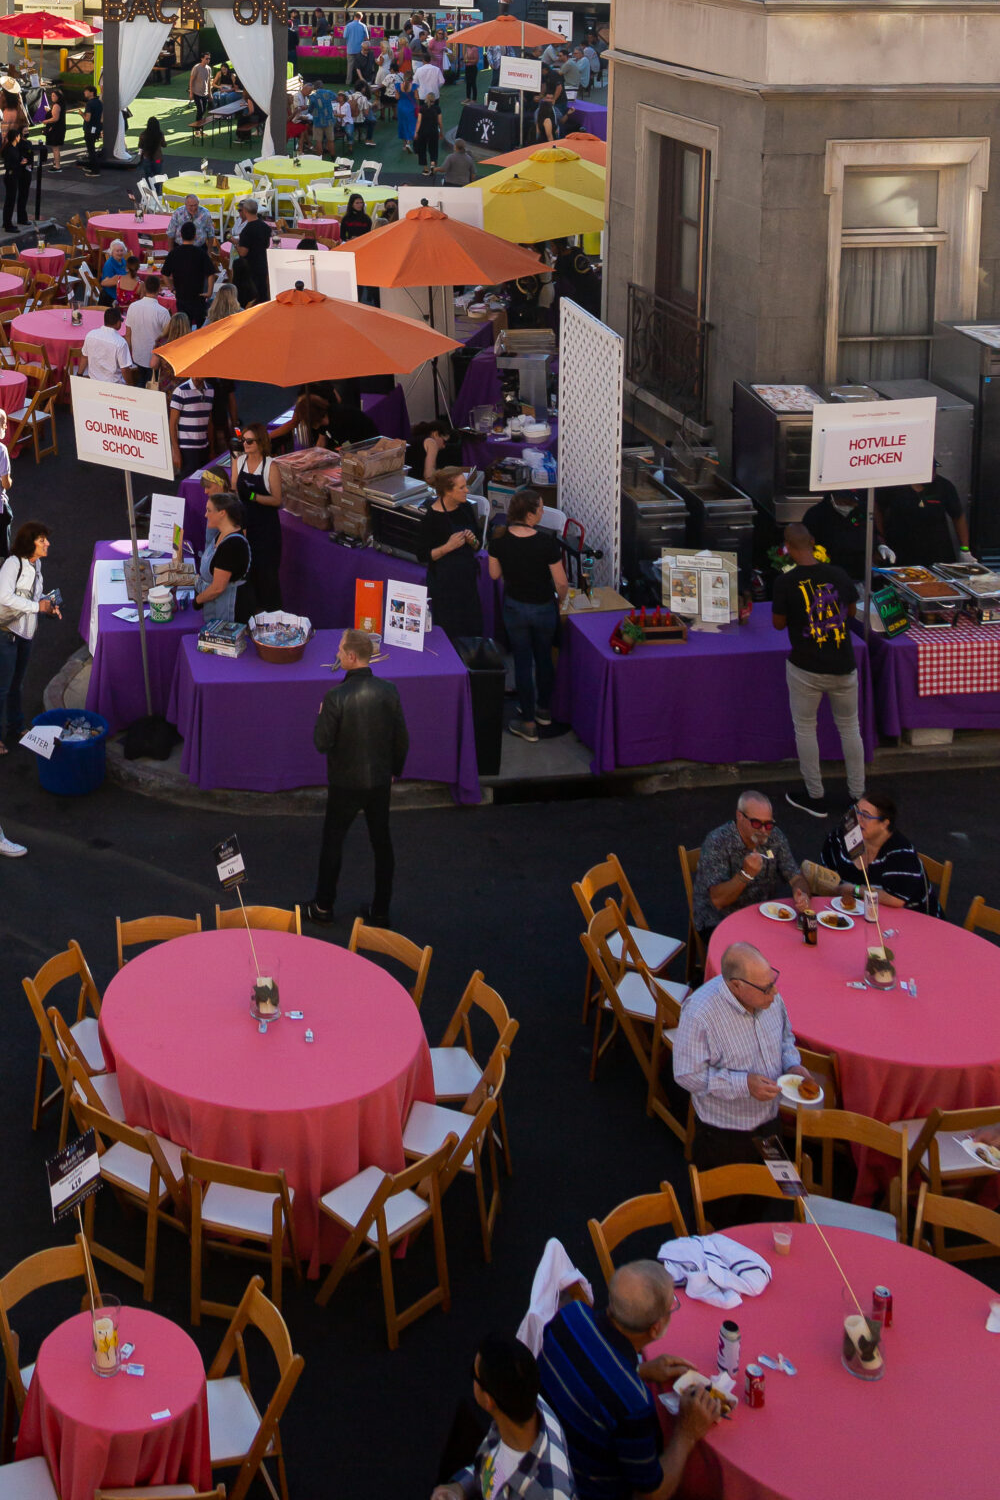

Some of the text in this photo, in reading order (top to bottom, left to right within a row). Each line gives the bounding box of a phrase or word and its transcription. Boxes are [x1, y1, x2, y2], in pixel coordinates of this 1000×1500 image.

[109, 407, 130, 422] THE
[85, 419, 159, 445] GOURMANDISE
[102, 439, 145, 459] SCHOOL
[848, 434, 907, 451] HOTVILLE
[849, 452, 902, 467] CHICKEN
[26, 733, 49, 750] WATER
